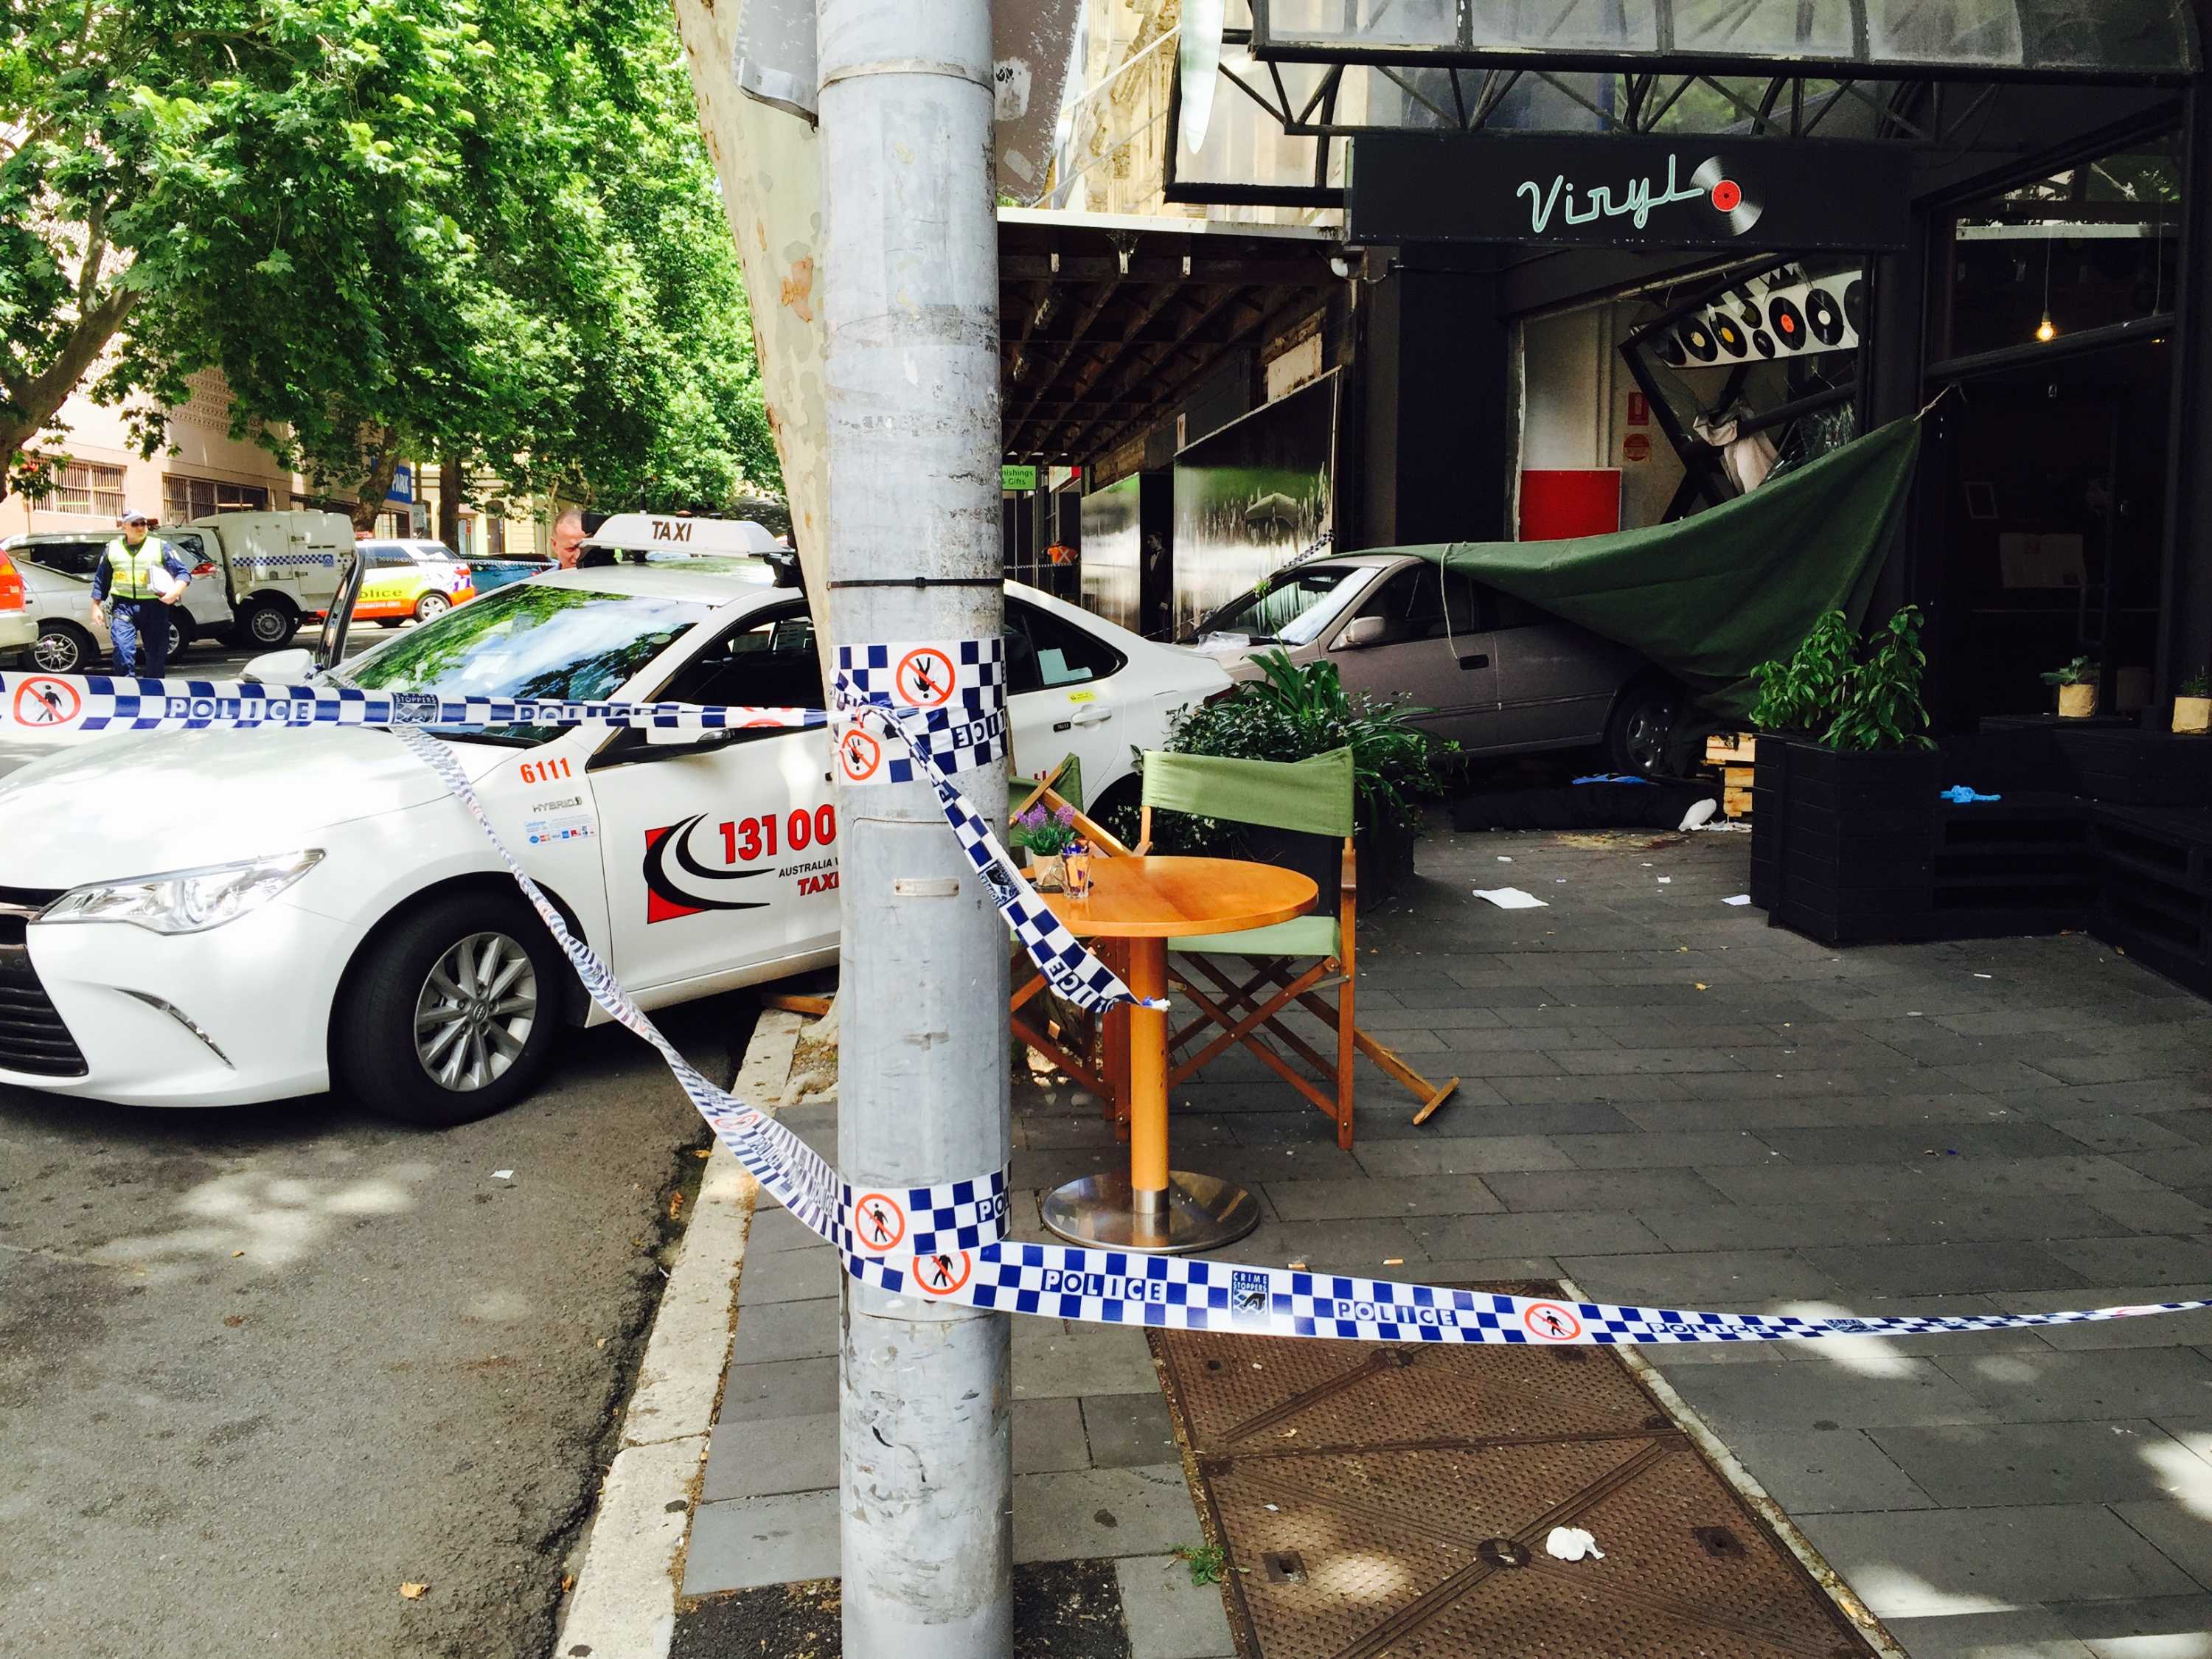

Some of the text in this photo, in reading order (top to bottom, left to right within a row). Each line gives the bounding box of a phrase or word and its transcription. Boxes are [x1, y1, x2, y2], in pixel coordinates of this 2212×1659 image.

[1516, 153, 1705, 234] Vinyl
[1003, 468, 1033, 477] nishings
[392, 473, 409, 495] PARK
[652, 521, 692, 542] TAXI
[358, 589, 403, 599] olice
[168, 698, 310, 720] POLICE
[953, 709, 1006, 747] LICE
[520, 757, 571, 783] 6111
[533, 799, 576, 812] HYBRID
[719, 803, 837, 865] 131 00
[779, 858, 833, 878] AUSTRALIA
[978, 1186, 1009, 1221] POL
[1044, 1270, 1161, 1301] POLICE
[1233, 1272, 1267, 1284] CRIME
[1233, 1281, 1267, 1293] STOPPERS
[1338, 1301, 1454, 1326] POLICE
[1649, 1322, 1771, 1334] POLICE
